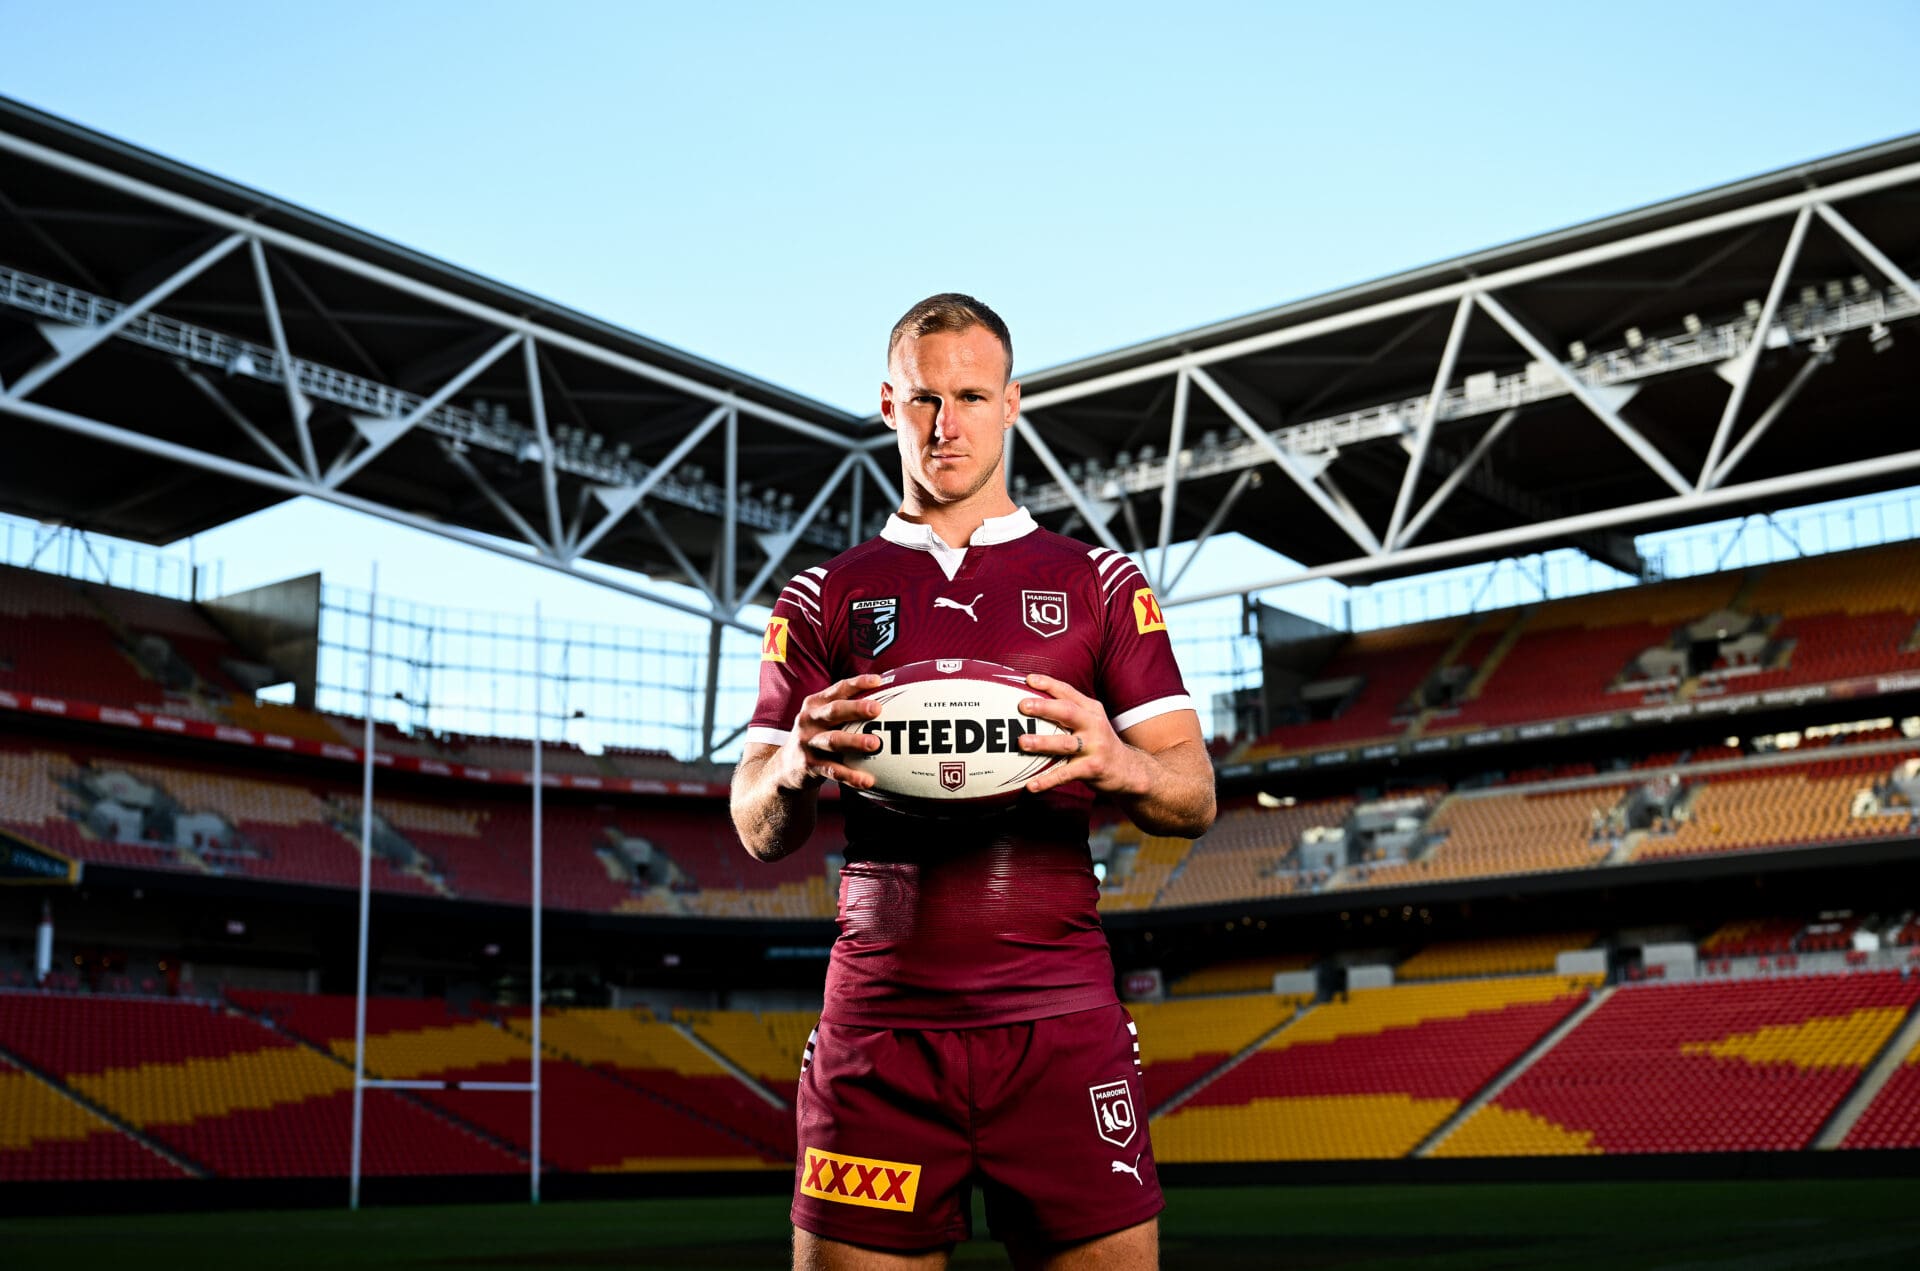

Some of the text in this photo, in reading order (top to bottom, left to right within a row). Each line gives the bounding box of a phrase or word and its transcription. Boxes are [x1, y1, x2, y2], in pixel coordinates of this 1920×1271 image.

[856, 600, 893, 608] AMPOL
[862, 718, 1037, 755] STEEDEN
[1096, 1087, 1126, 1100] MAROONS
[805, 1155, 912, 1204] XXXX
